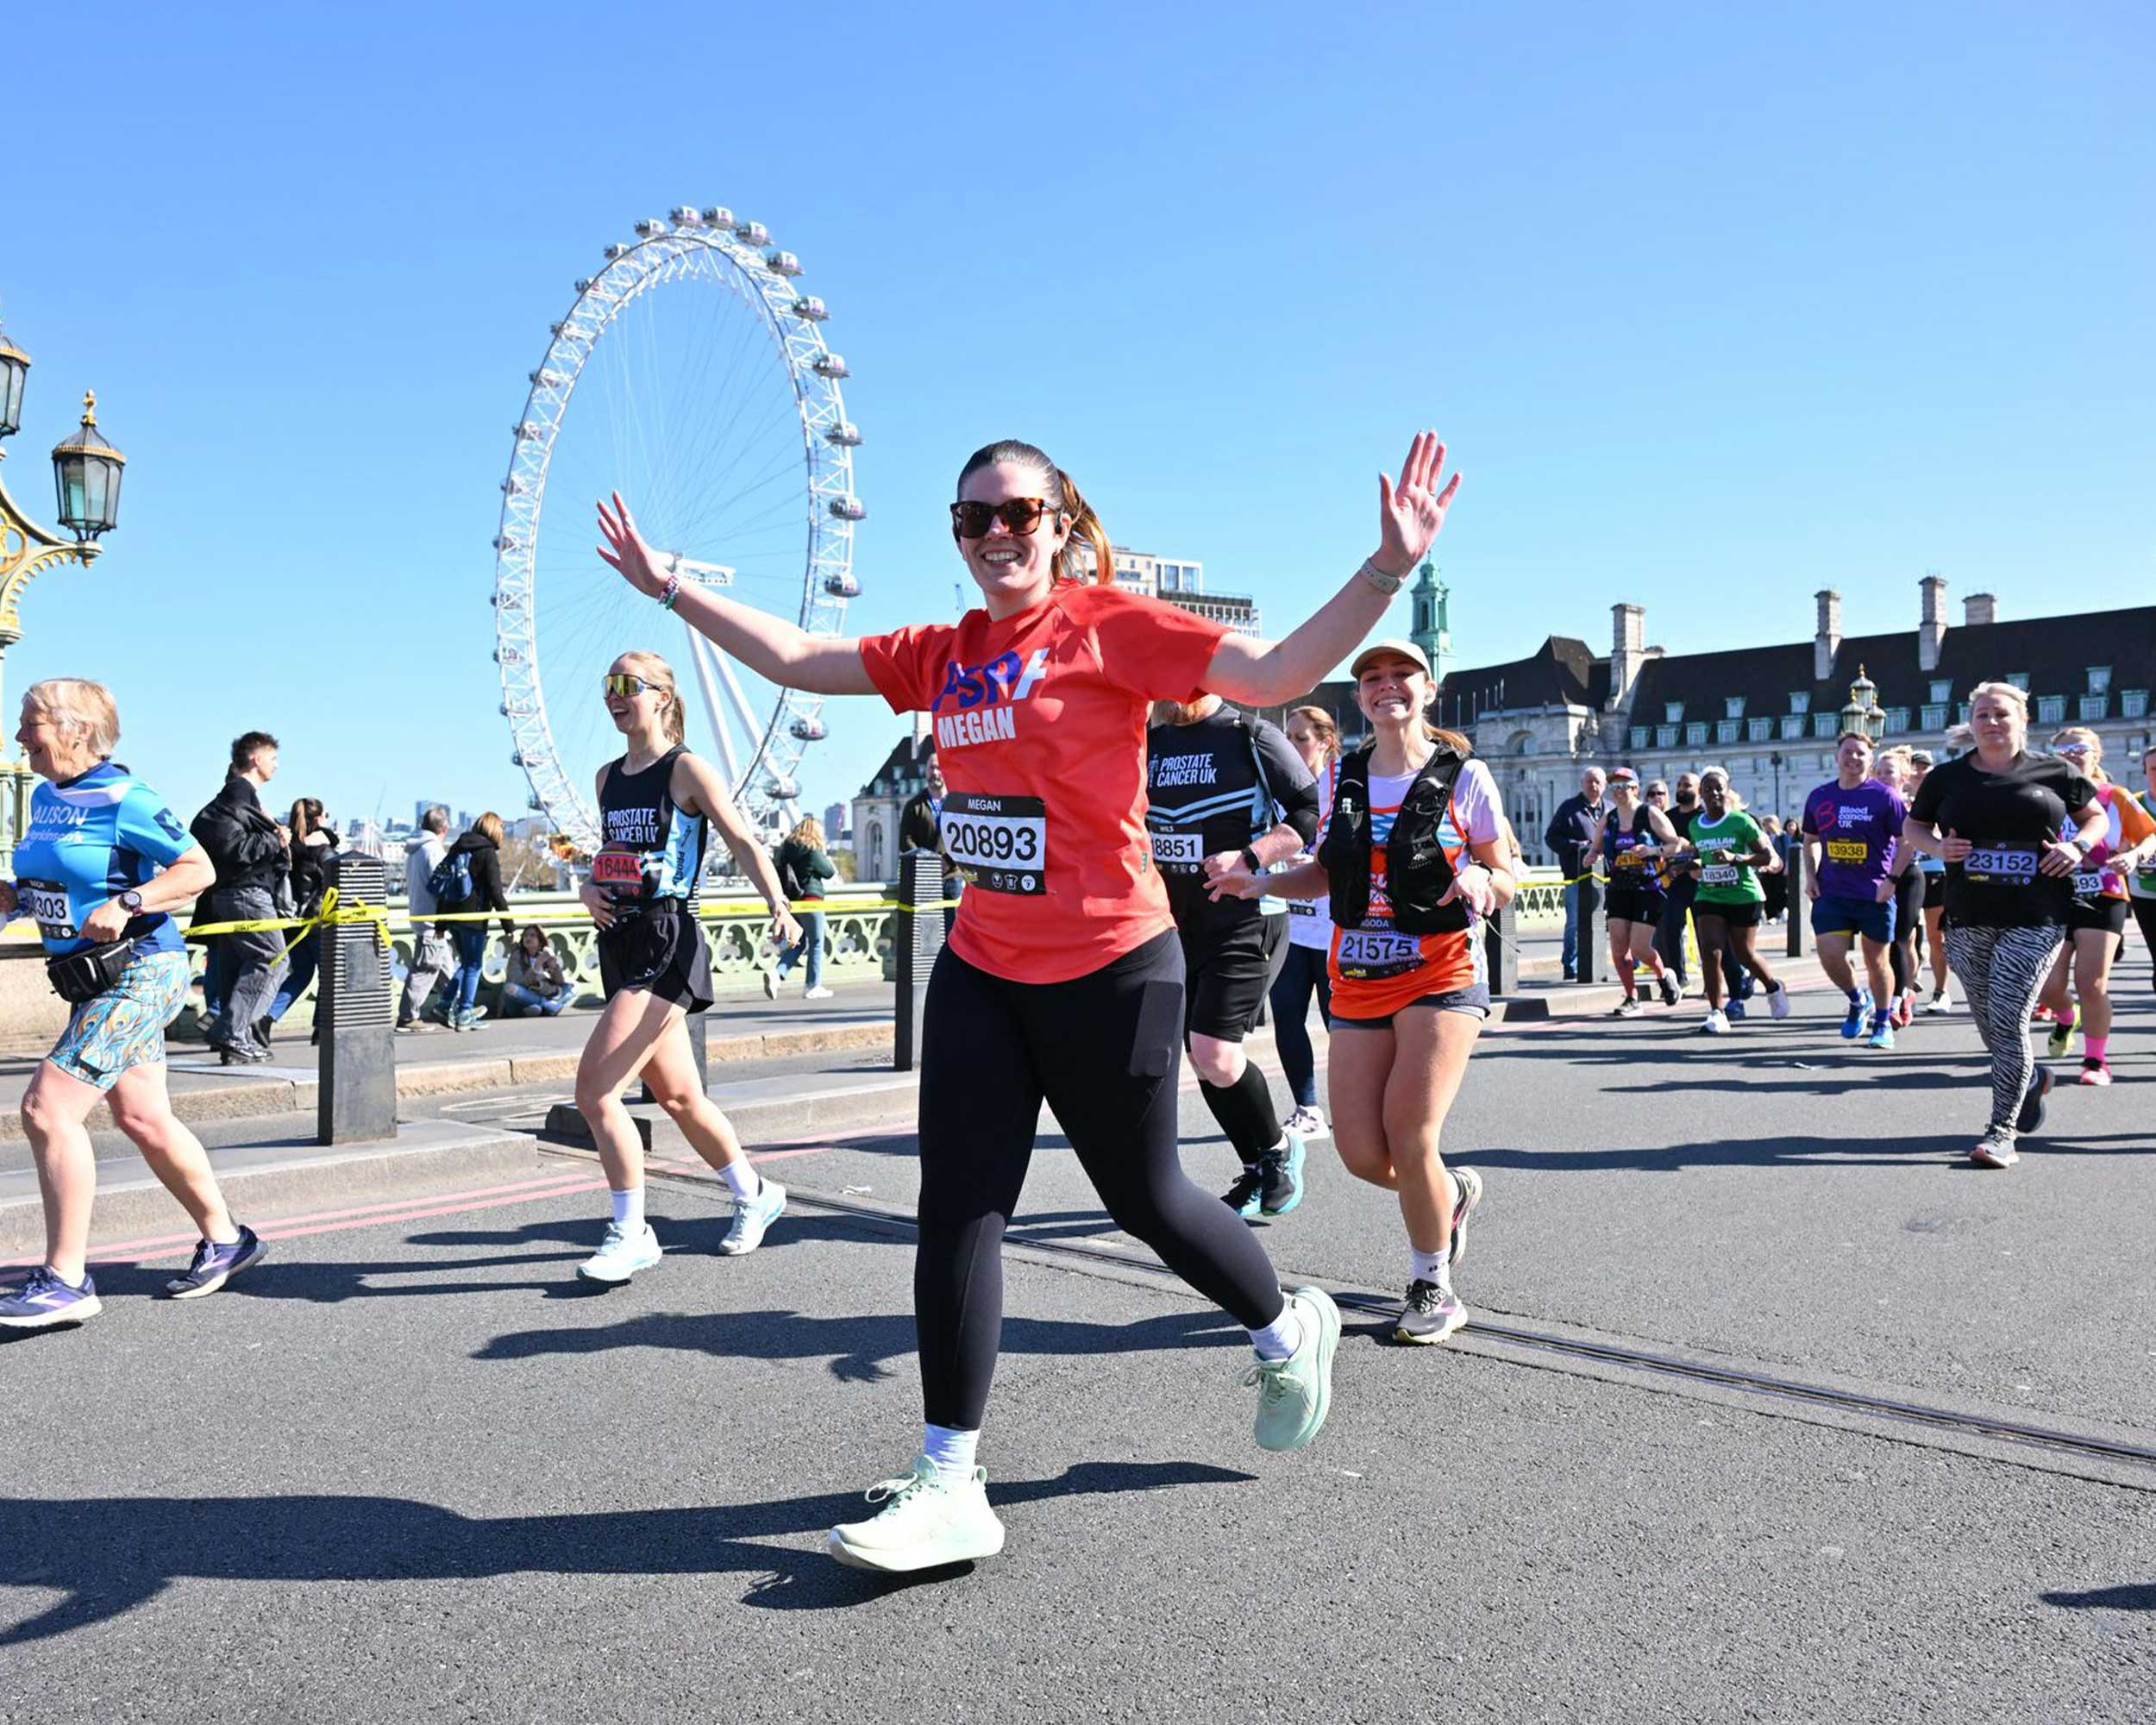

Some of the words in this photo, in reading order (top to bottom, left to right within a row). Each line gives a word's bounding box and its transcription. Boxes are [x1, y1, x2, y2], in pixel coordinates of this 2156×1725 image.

[937, 706, 1016, 749] MEGAN
[1160, 753, 1213, 772] PROSTATE
[1156, 768, 1198, 787] CANCER
[1200, 768, 1217, 784] UK
[968, 799, 1001, 812] MEGAN
[1839, 806, 1868, 814] Blood
[33, 806, 89, 825] ALISON
[607, 808, 656, 828] PROSTATE
[1838, 813, 1873, 822] cancer
[947, 822, 1037, 861] 20893
[1151, 838, 1195, 857] 8851
[1829, 845, 1864, 856] 13938
[598, 857, 637, 878] 16444
[1969, 853, 2033, 871] 23152
[2075, 876, 2099, 889] 93
[33, 896, 66, 919] 303
[1341, 937, 1413, 960] 21575
